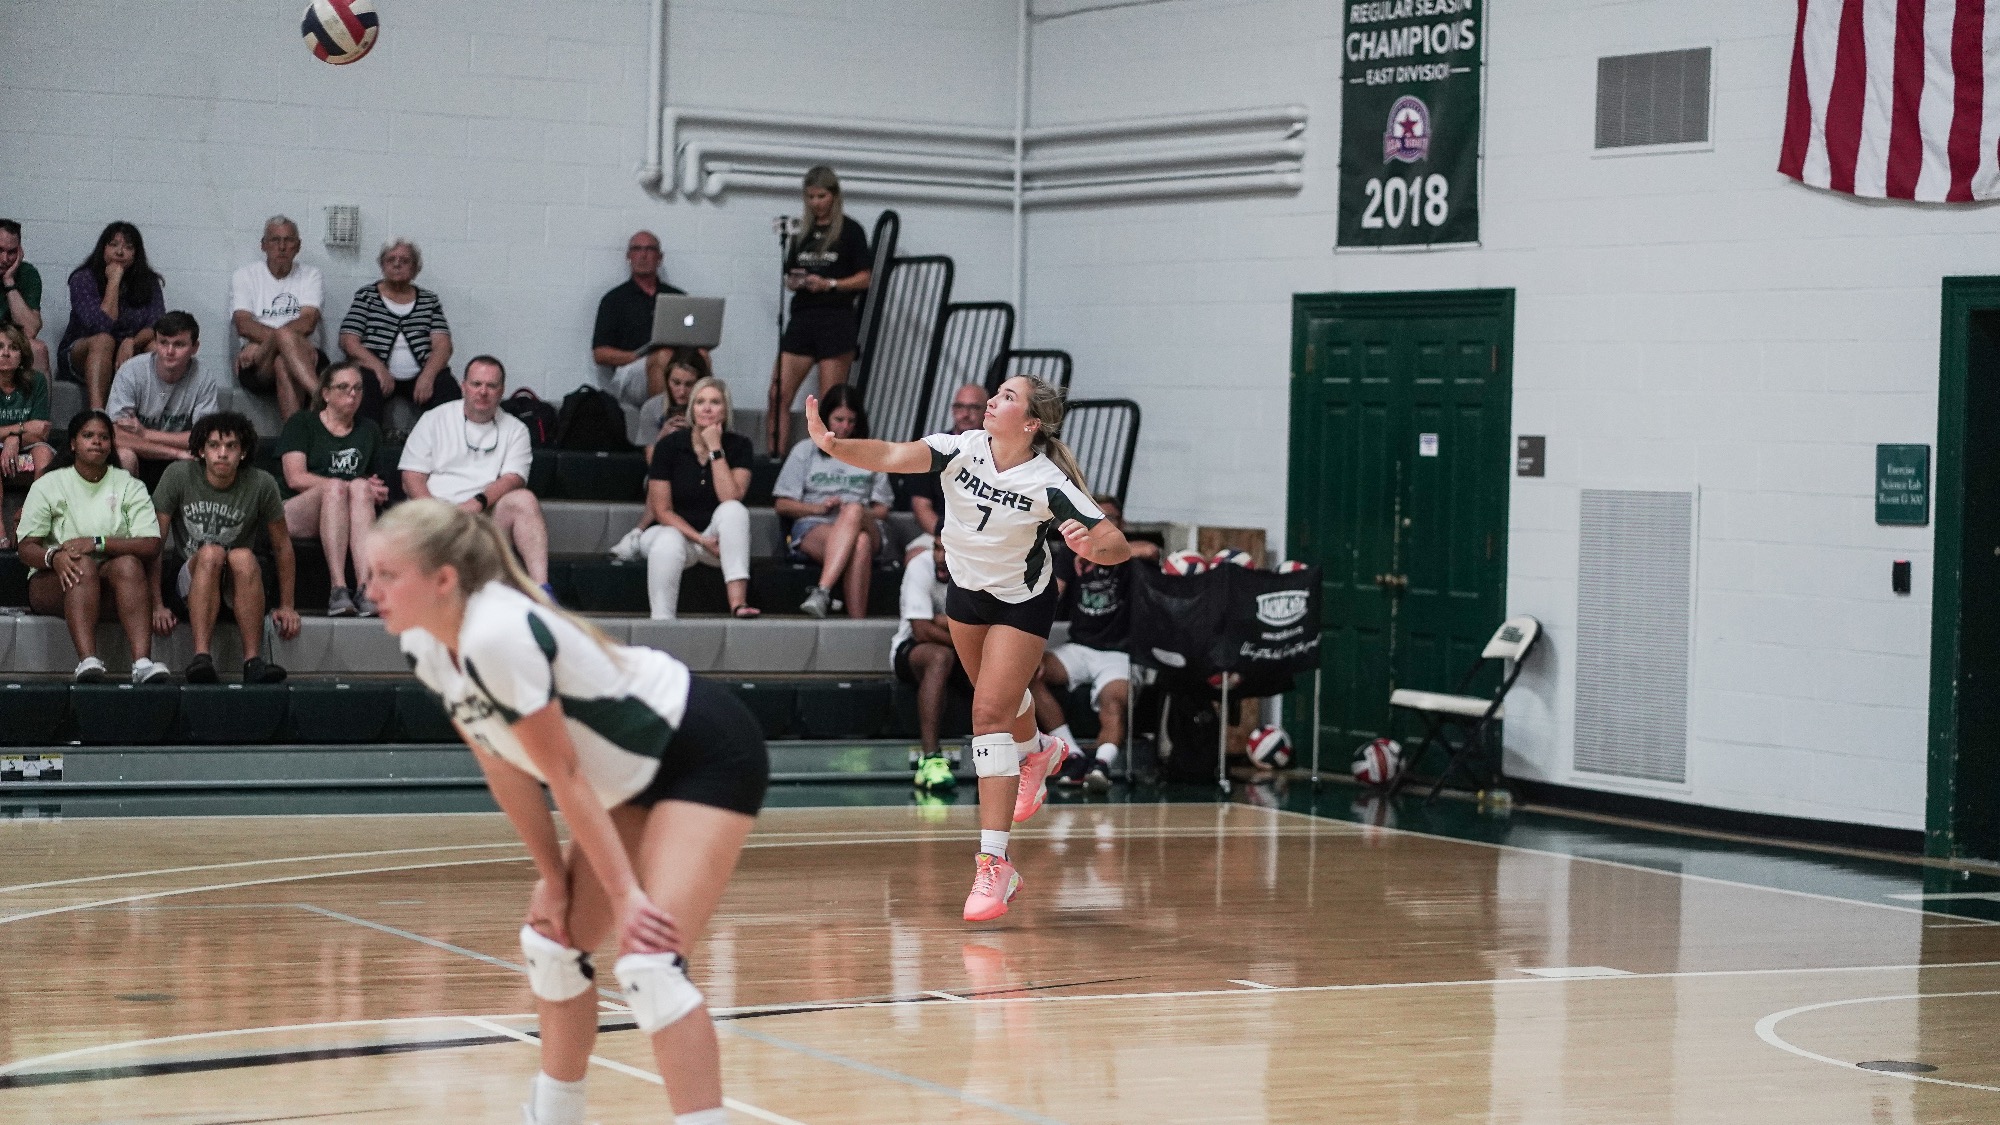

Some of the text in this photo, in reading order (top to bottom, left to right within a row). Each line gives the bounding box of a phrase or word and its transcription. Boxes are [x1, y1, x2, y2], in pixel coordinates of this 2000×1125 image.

[1350, 0, 1473, 23] REGULAR SEASN
[1366, 67, 1395, 85] EAST
[1361, 173, 1449, 229] 2018
[954, 466, 1035, 512] PACERS
[976, 503, 993, 532] 7
